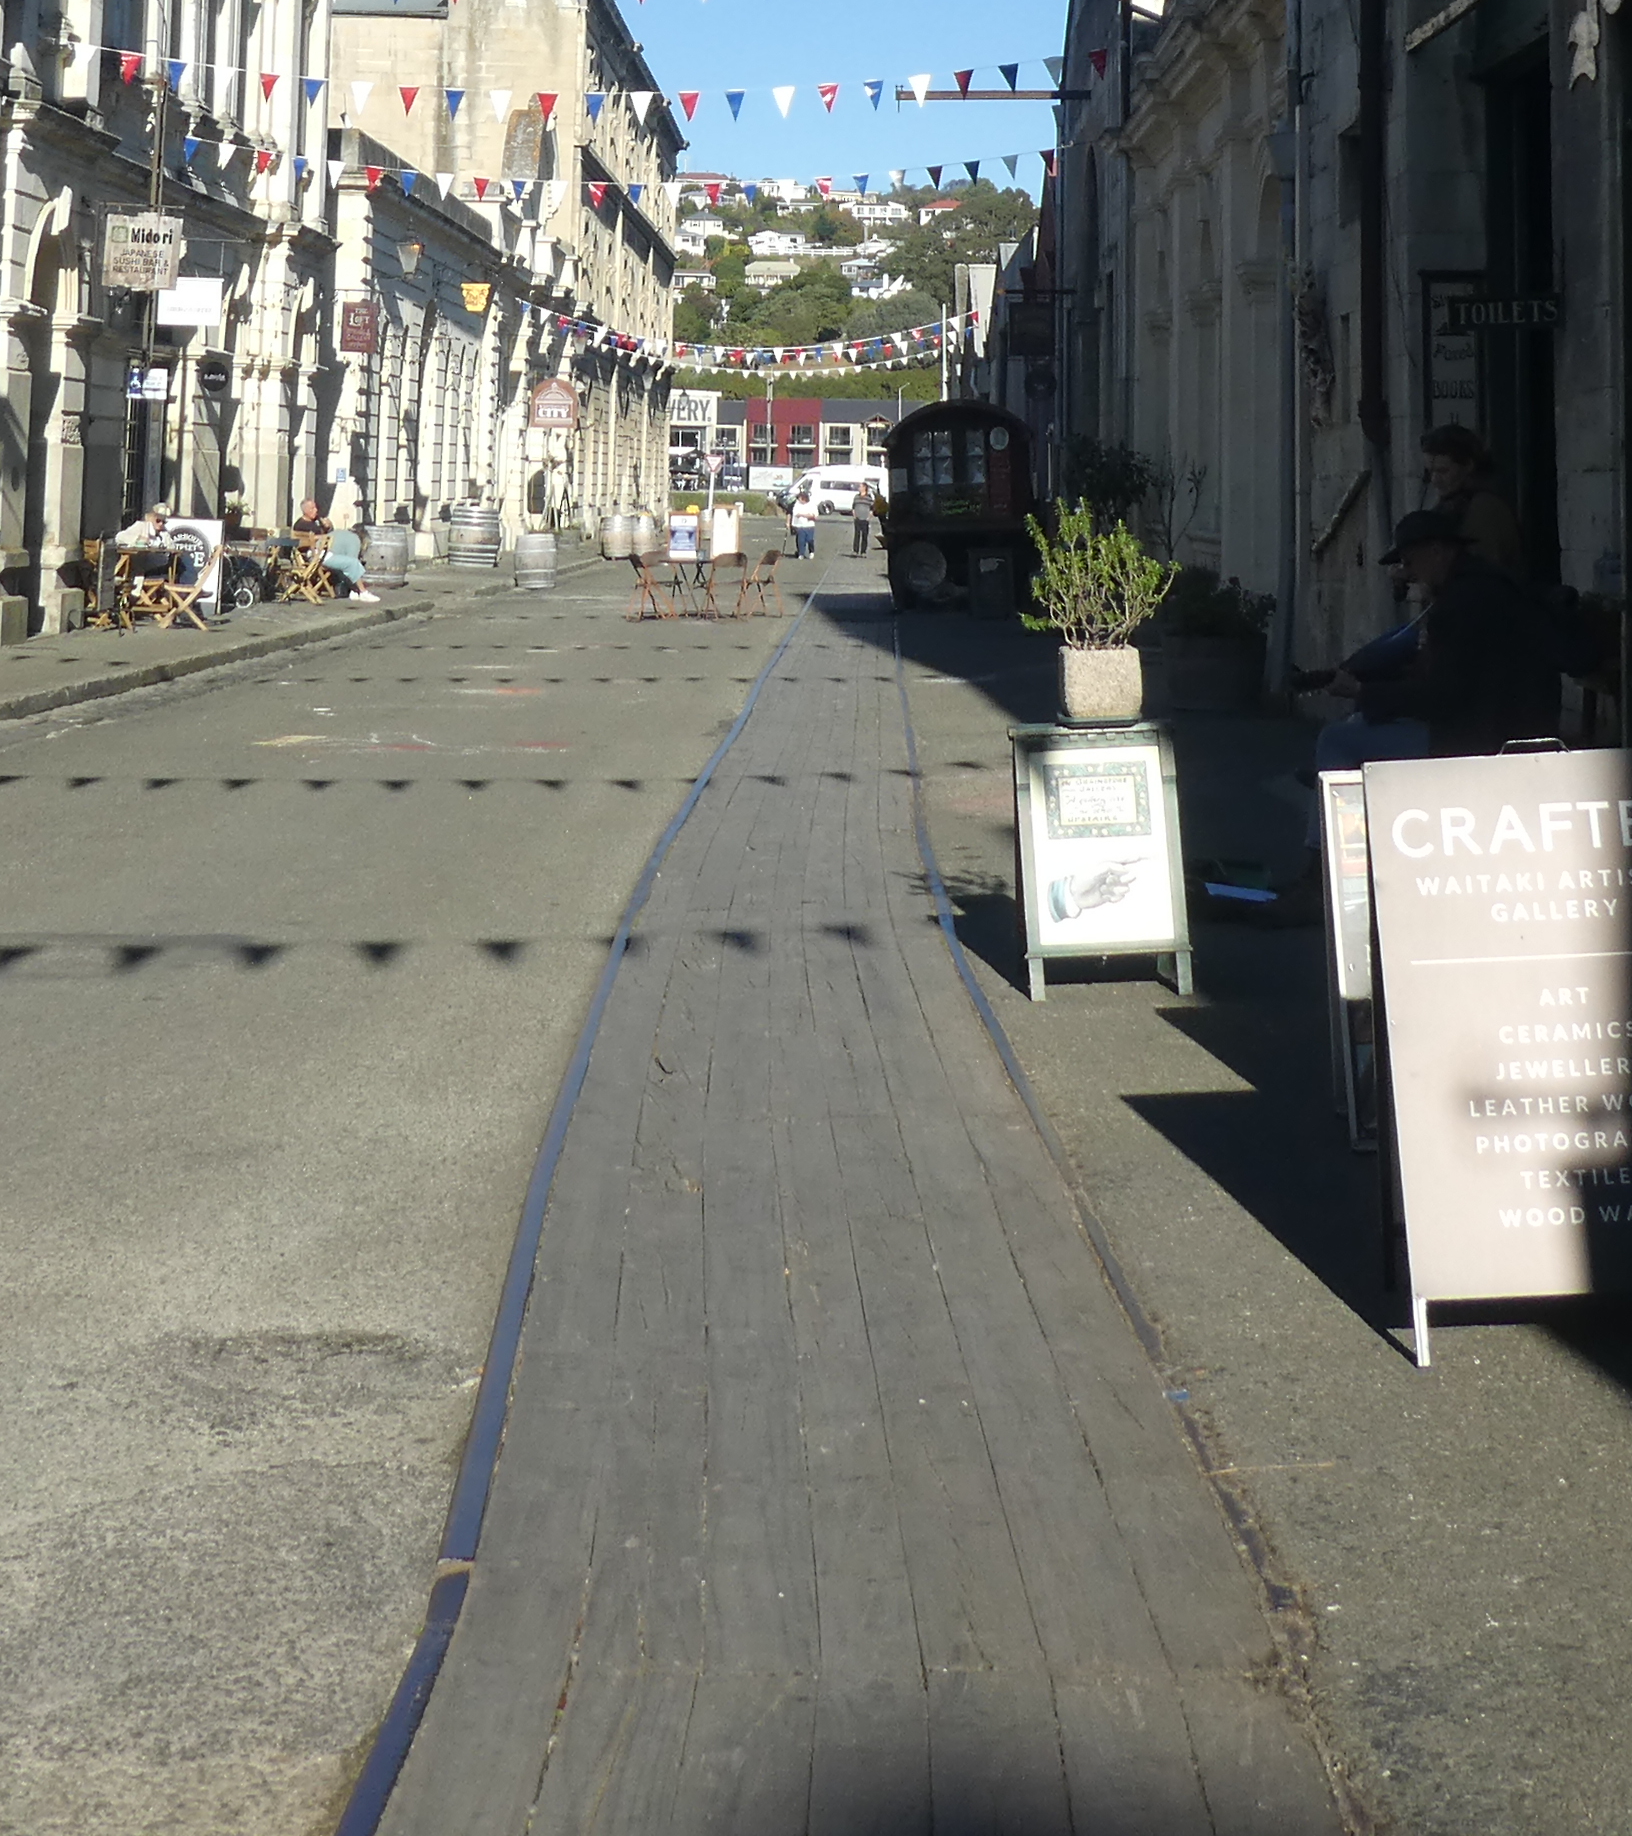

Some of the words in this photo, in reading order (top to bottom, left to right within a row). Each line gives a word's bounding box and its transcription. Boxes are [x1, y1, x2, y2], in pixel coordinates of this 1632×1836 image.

[131, 228, 174, 244] Midori
[113, 256, 141, 265] SUSHI
[143, 258, 161, 266] BAR
[121, 248, 164, 258] JAPANESE
[112, 265, 169, 275] RESTAURANT
[1454, 300, 1559, 325] TOILETS
[1433, 380, 1475, 399] BOOKS
[1415, 872, 1544, 896] WAITAKI
[1490, 898, 1618, 923] GALLERY
[1539, 987, 1589, 1007] ART
[1469, 1096, 1589, 1117] LEATHER
[1498, 1206, 1586, 1228] WOOD
